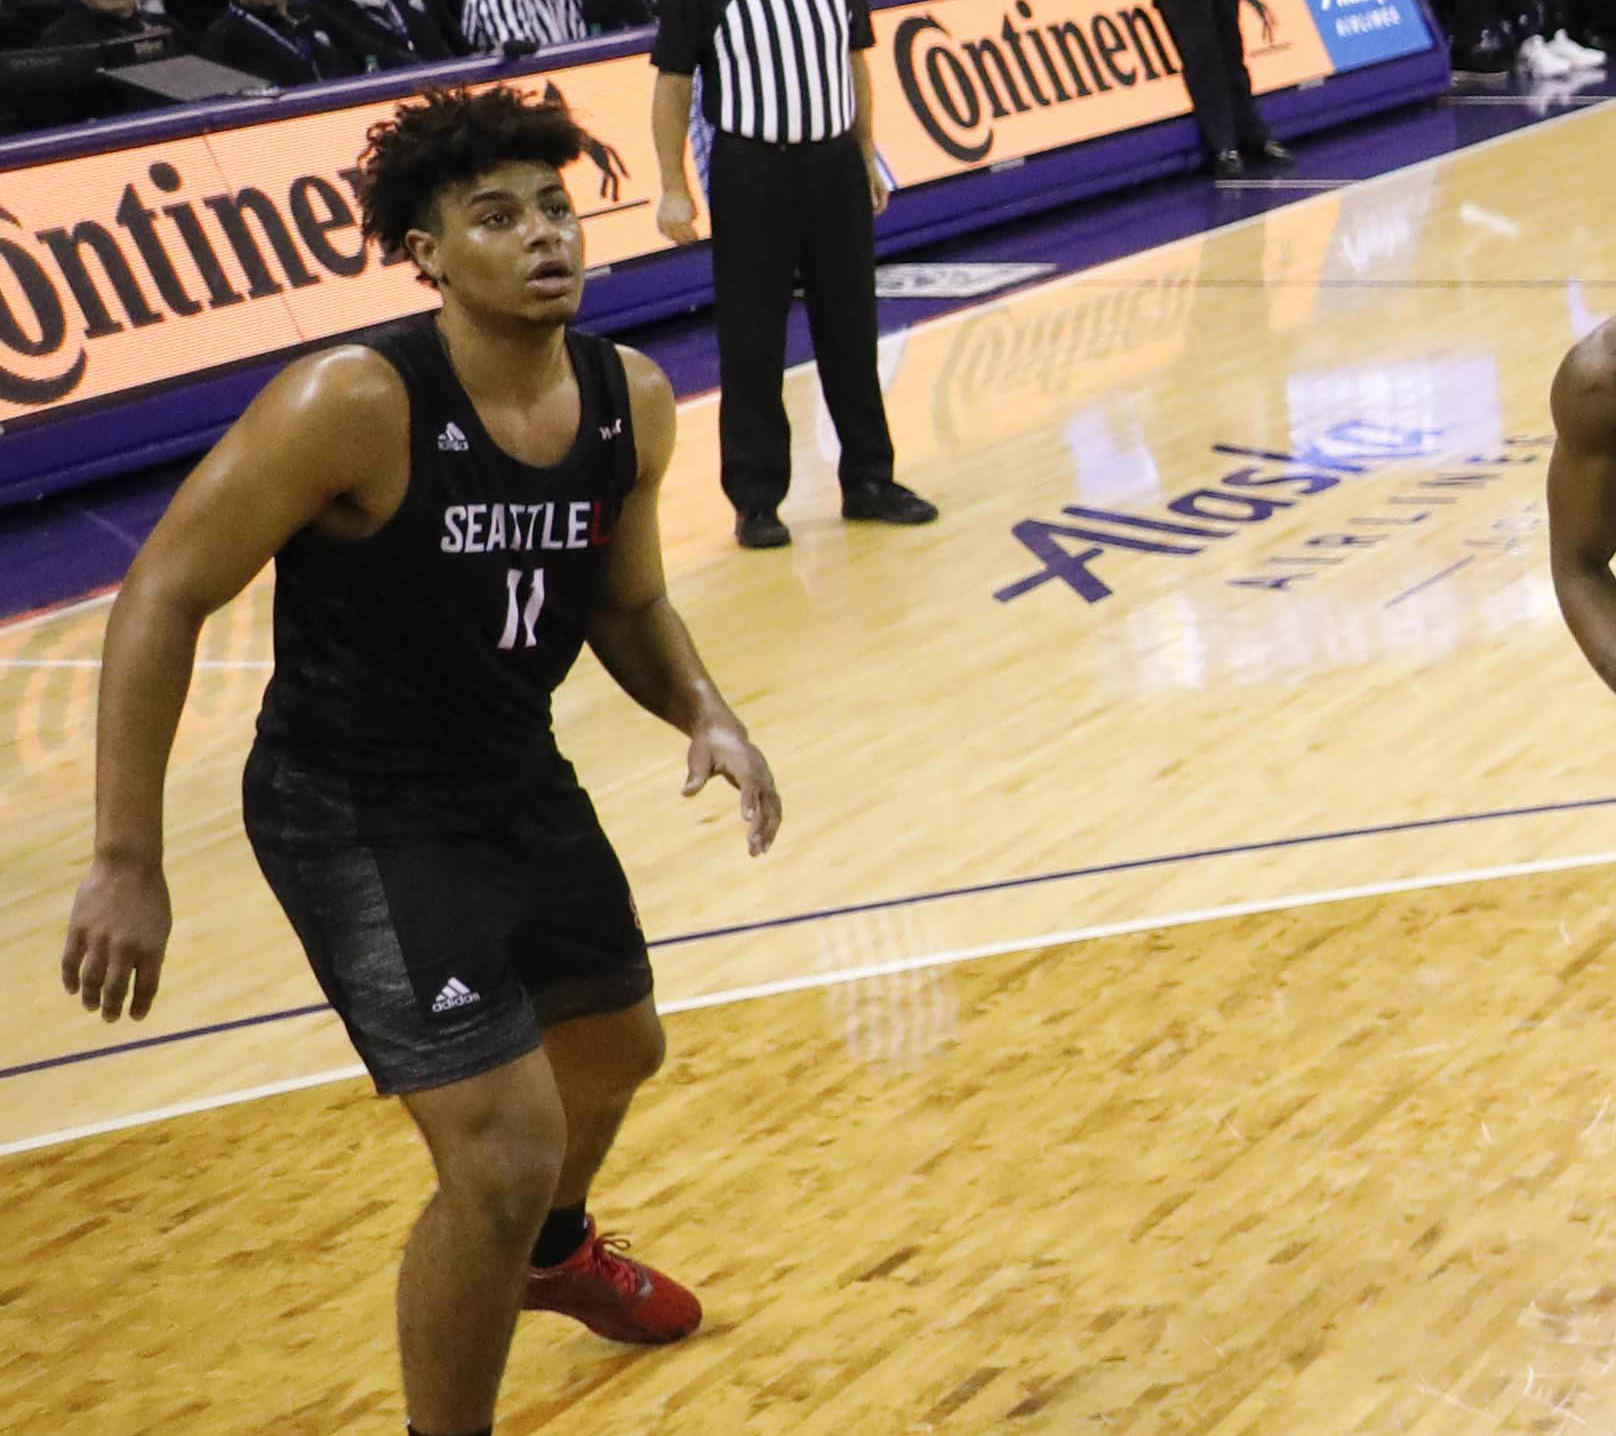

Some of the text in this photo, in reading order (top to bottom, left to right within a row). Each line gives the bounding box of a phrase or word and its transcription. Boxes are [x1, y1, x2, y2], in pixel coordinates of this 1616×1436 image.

[894, 0, 1186, 164] Continen
[992, 418, 1446, 605] Alaska
[496, 566, 546, 651] 11
[432, 992, 481, 1013] adidas
